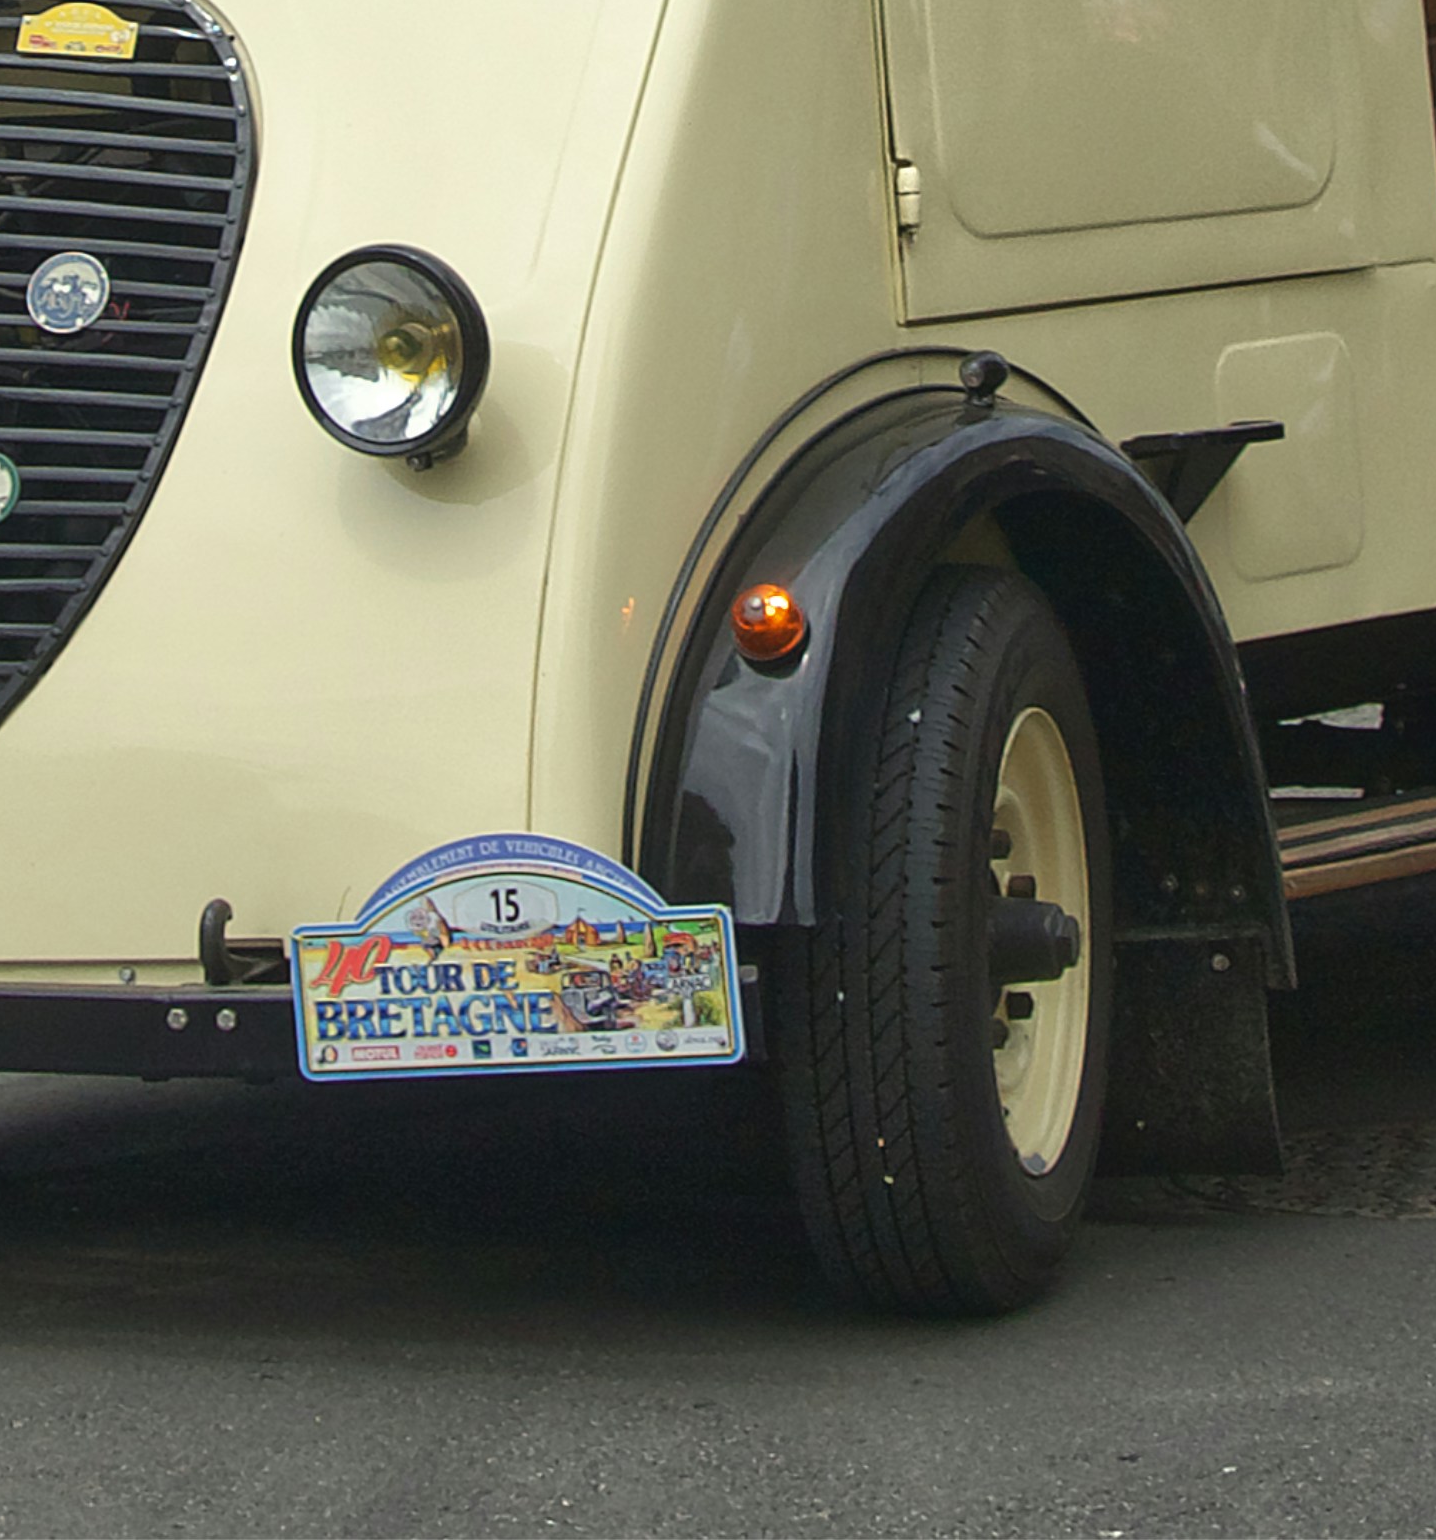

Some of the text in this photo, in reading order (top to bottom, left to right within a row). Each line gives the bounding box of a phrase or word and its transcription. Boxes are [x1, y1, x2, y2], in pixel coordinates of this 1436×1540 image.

[481, 840, 500, 856] DE
[490, 888, 520, 923] 15
[372, 962, 465, 995] TOUR
[472, 959, 519, 991] DE
[314, 991, 559, 1041] BRETAGNE
